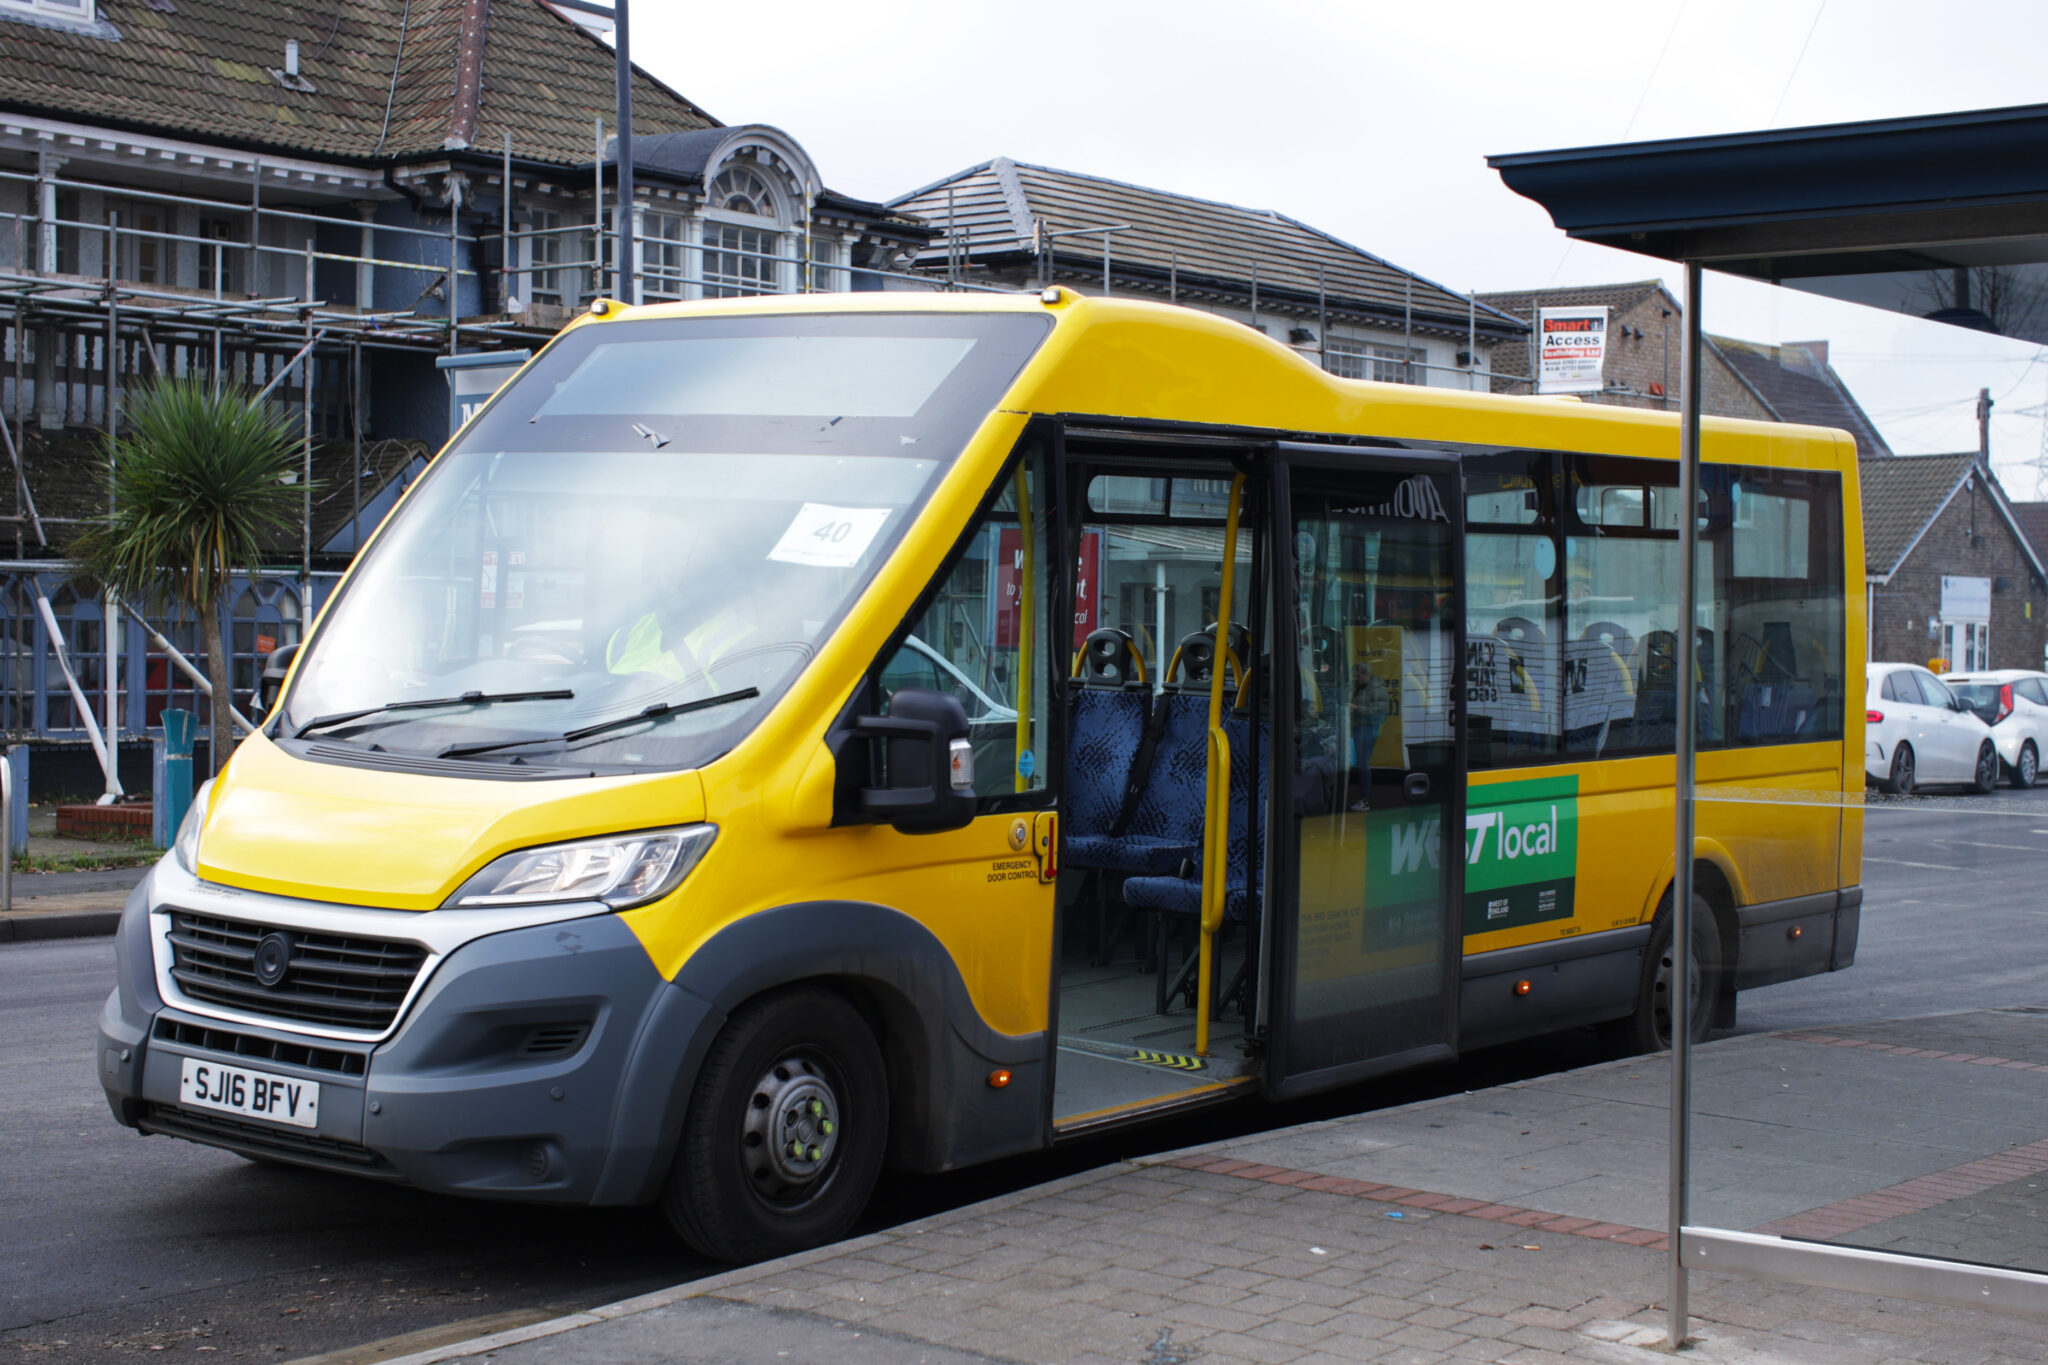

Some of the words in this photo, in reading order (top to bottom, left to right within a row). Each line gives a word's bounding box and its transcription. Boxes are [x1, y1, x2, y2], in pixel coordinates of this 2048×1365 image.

[1544, 319, 1590, 332] Smart
[1545, 335, 1600, 346] Access
[813, 520, 853, 543] 40
[1497, 804, 1558, 861] local
[993, 861, 1032, 871] EMERGENCY
[988, 872, 1006, 882] DOOR
[1008, 870, 1038, 880] CONTROL
[1491, 899, 1503, 908] WEST
[1503, 898, 1509, 906] OF
[1491, 906, 1509, 915] ENGLAND
[195, 1066, 246, 1108] SJ16
[252, 1077, 302, 1118] BFV
